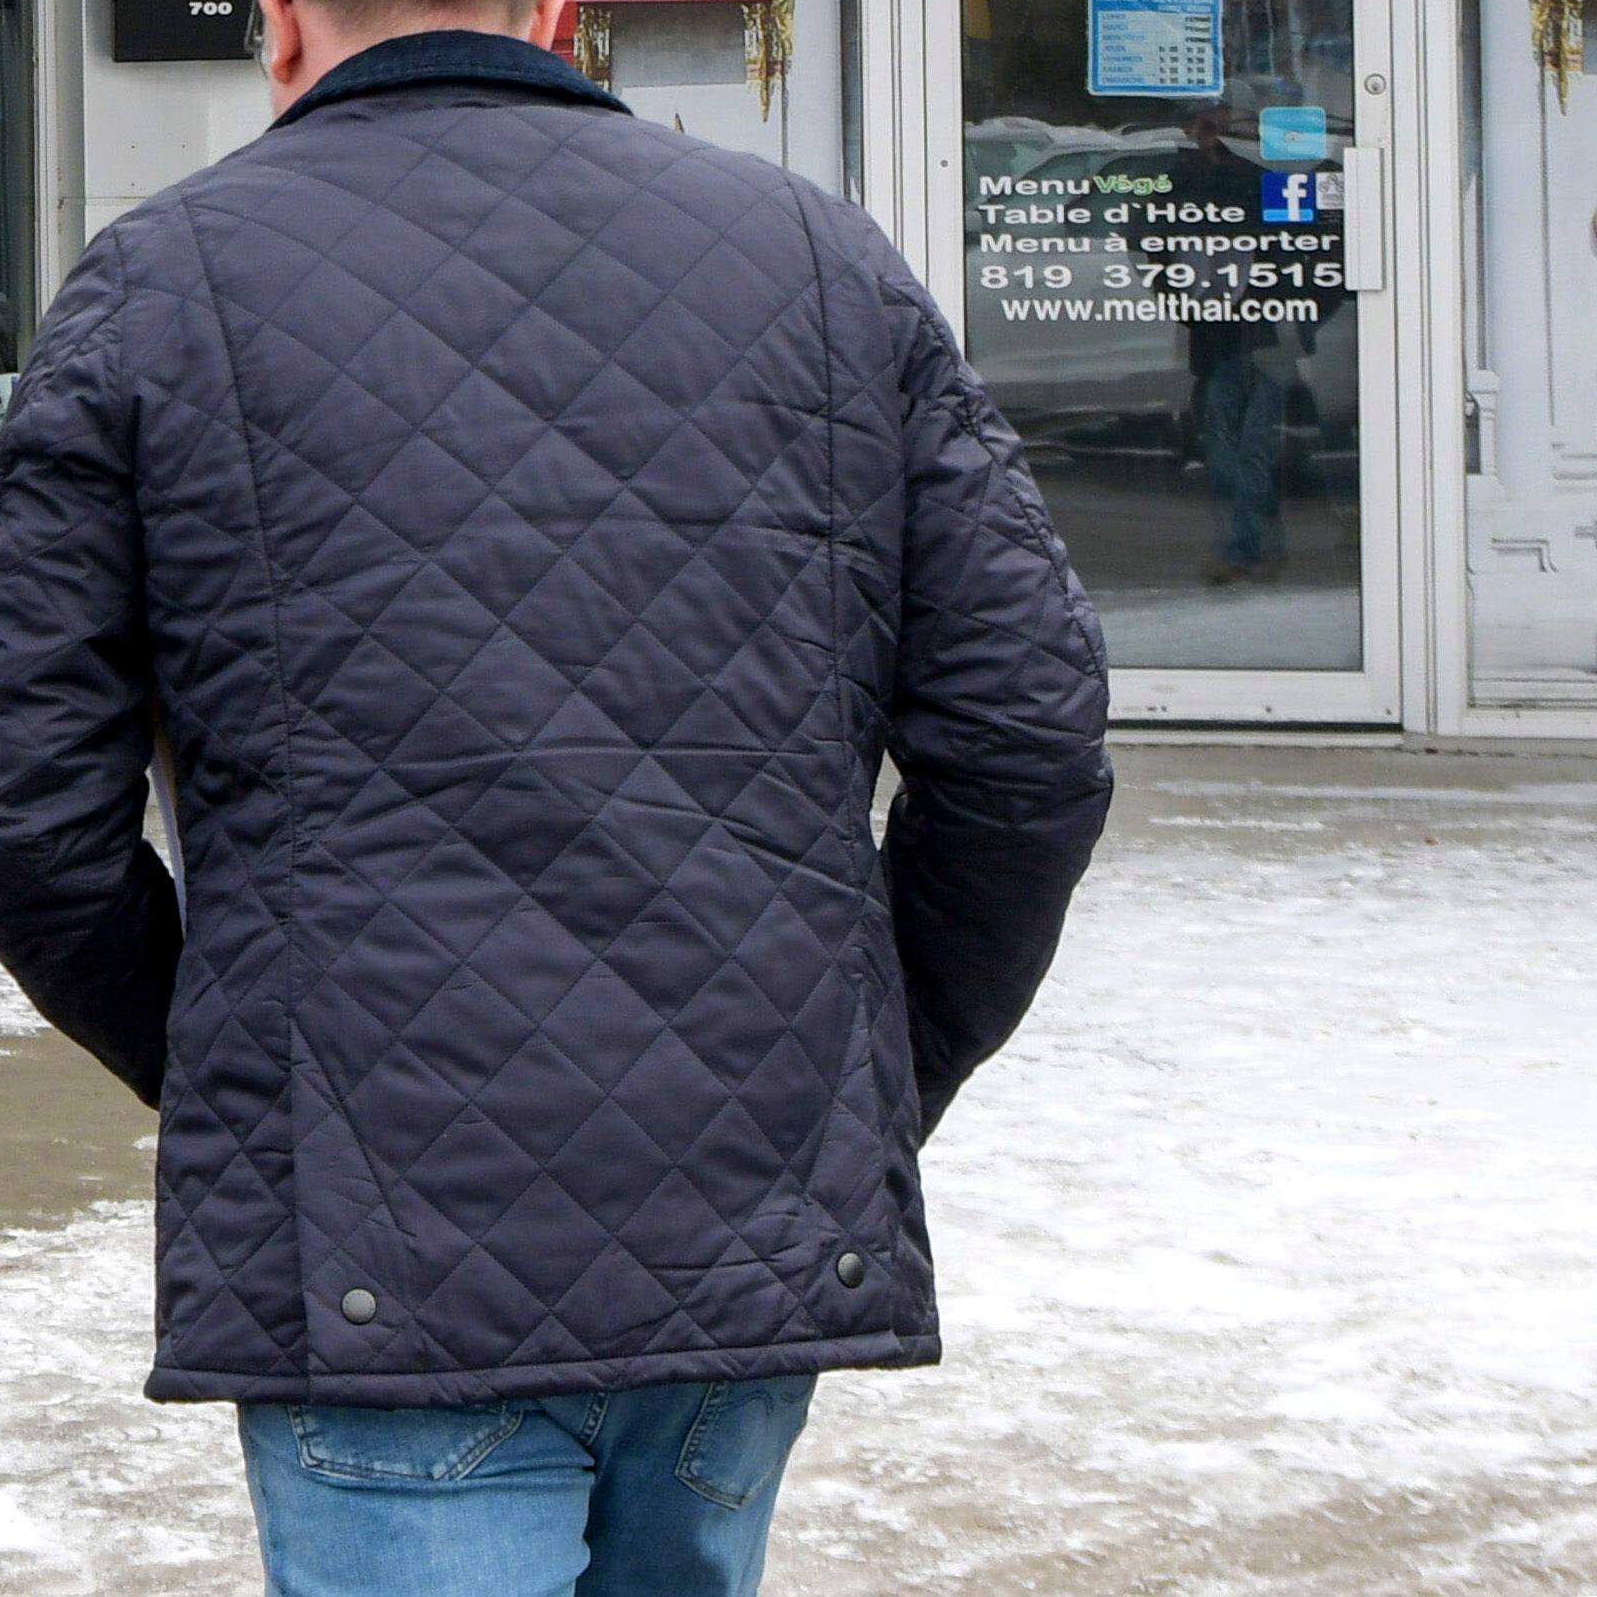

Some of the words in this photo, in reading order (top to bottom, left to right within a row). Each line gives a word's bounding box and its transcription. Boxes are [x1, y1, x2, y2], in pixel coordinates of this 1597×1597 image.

[188, 1, 234, 16] 700
[978, 175, 1090, 195] Menu
[1093, 173, 1174, 197] Végé
[978, 203, 1092, 224] Table
[978, 233, 1091, 253] Menu
[1103, 231, 1129, 253] à
[1140, 231, 1340, 256] emporter
[979, 263, 1073, 289] 819
[1103, 262, 1343, 289] 379.1515
[1001, 292, 1319, 323] www.melthai.com
